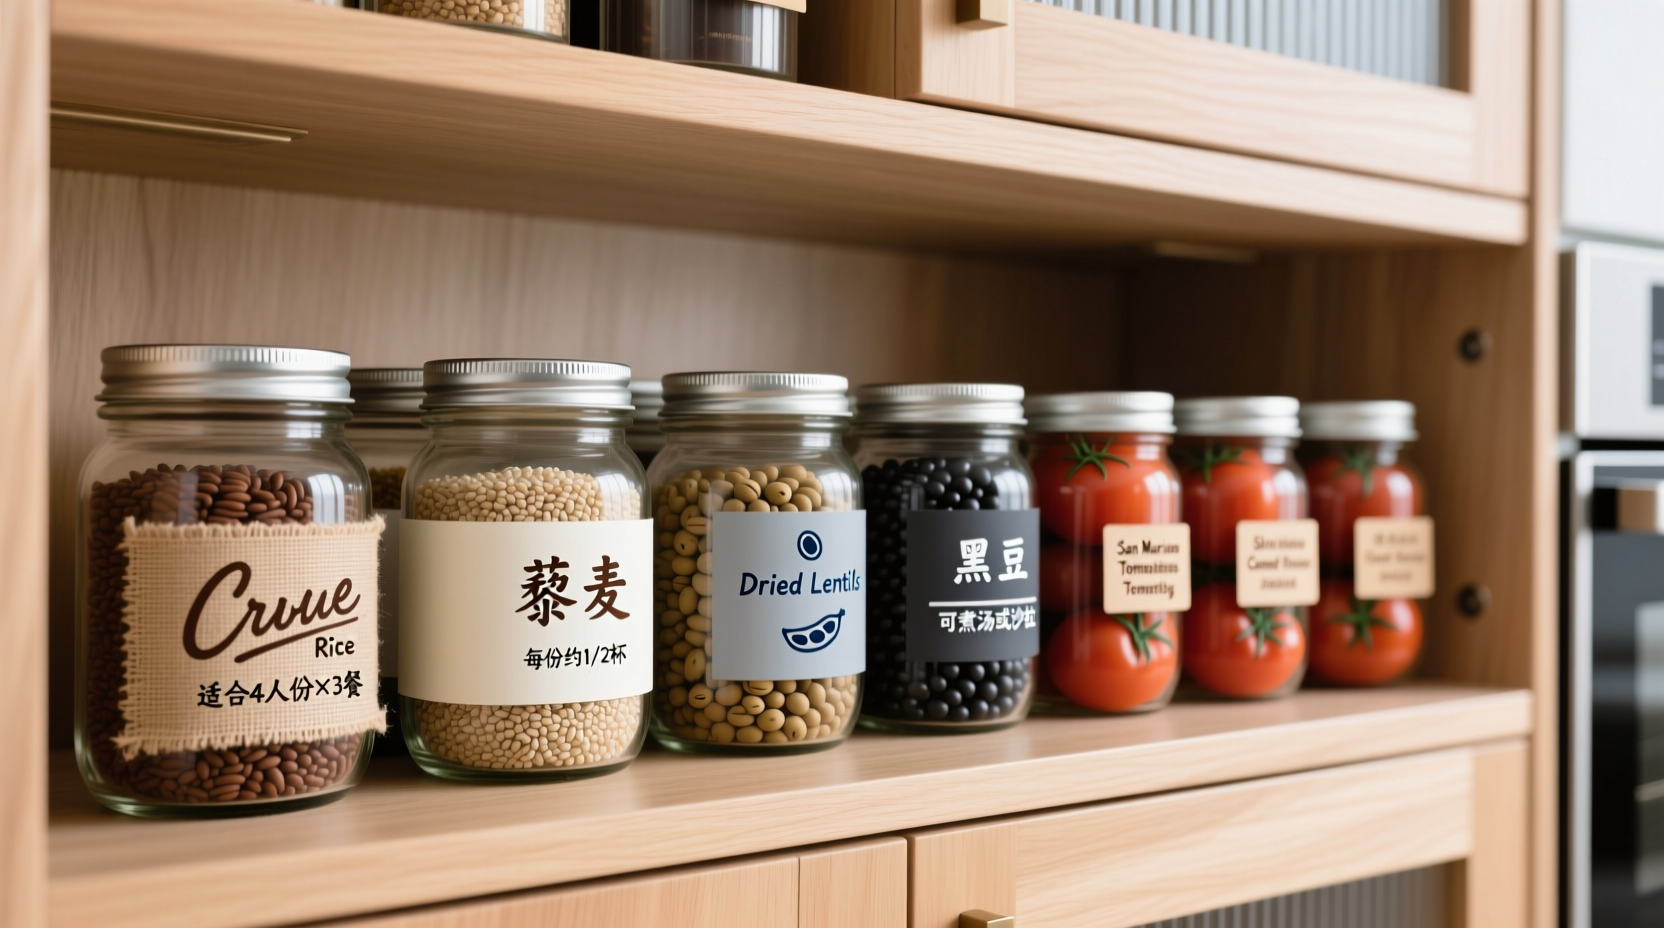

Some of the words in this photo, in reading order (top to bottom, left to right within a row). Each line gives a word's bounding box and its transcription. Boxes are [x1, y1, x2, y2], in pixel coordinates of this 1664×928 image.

[953, 537, 1029, 585] 黑豆
[1117, 540, 1139, 555] San
[515, 555, 631, 627] 藜麦
[739, 572, 803, 596] Dried
[811, 569, 861, 594] Lentils
[315, 636, 355, 658] Rice
[523, 643, 627, 670] 每份约1/2杯
[197, 670, 363, 708] 适合4人份×3餐
